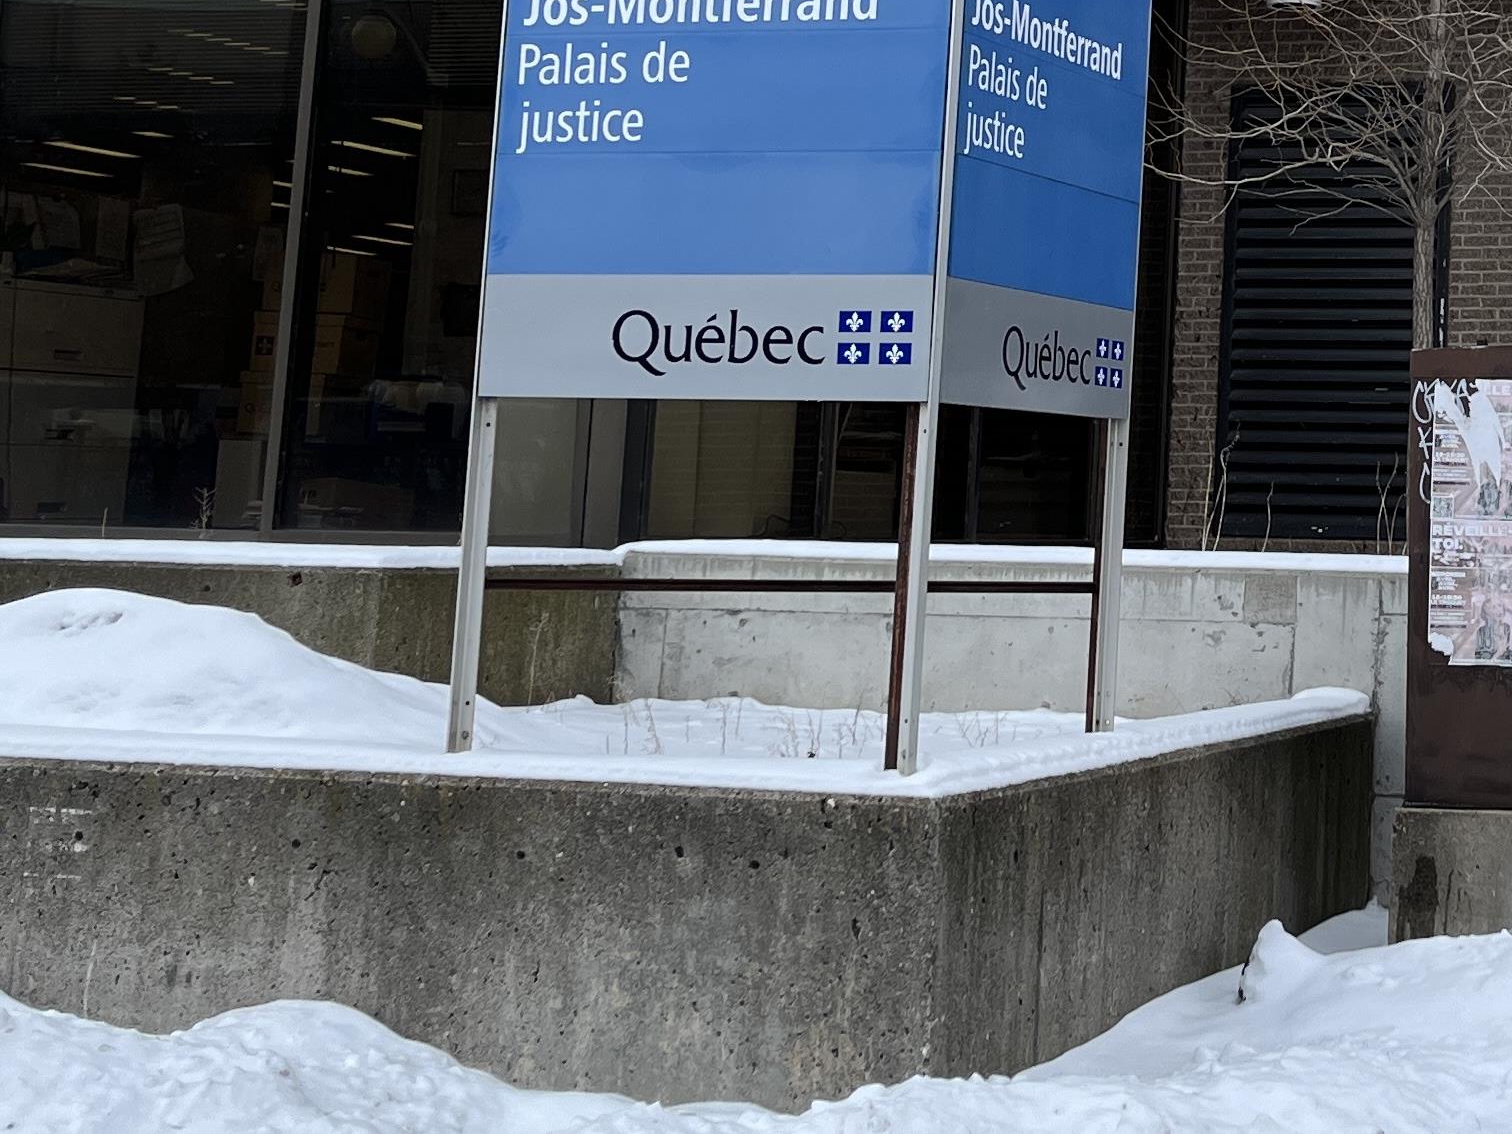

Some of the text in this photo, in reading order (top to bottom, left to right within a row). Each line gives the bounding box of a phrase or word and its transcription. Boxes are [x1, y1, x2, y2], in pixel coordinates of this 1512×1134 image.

[518, 40, 690, 85] Palais de
[968, 44, 1048, 109] Palais de
[515, 99, 644, 154] justice
[963, 101, 1025, 158] justice
[611, 309, 825, 376] Québec
[1002, 325, 1092, 391] Québec
